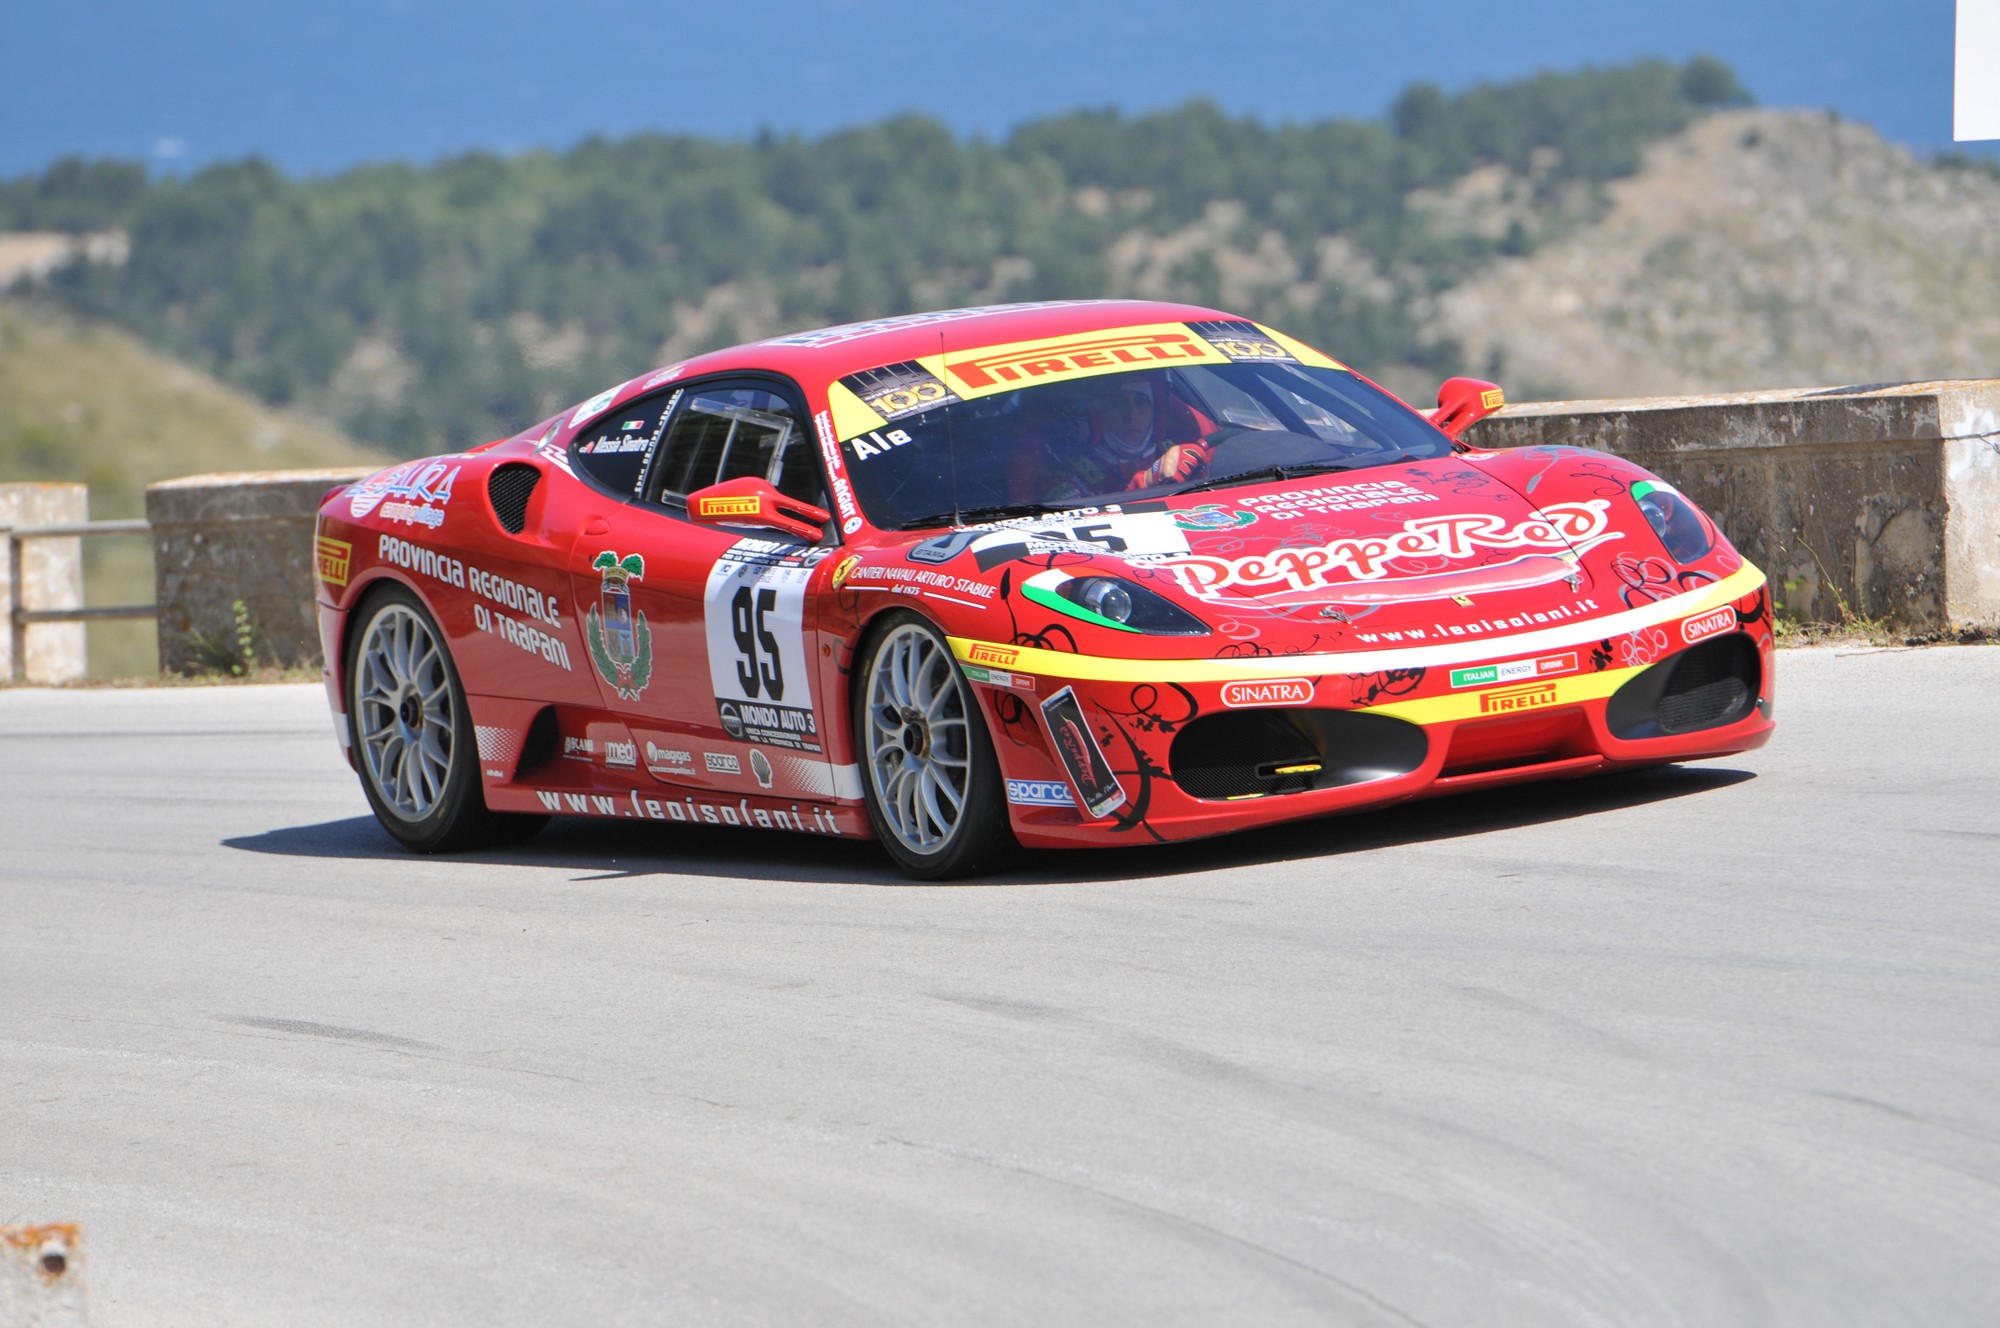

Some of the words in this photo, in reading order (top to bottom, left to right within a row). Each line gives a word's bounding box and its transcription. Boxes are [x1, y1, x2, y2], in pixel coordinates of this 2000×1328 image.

[945, 334, 1207, 389] PIRELLI
[1215, 340, 1289, 359] 100
[871, 383, 946, 413] 100
[851, 430, 912, 460] Ale
[702, 498, 758, 514] PIRELLI
[1104, 504, 1122, 513] 3
[1270, 510, 1305, 521] DI
[850, 566, 884, 579] CANTIERI
[883, 568, 914, 582] NAVALI
[913, 571, 955, 589] ARTURO
[954, 578, 997, 599] STABILE
[473, 603, 493, 635] DI
[1356, 598, 1599, 643] www.leoisolani.it
[1687, 611, 1734, 639] SINATRA
[732, 586, 784, 701] 95
[969, 643, 1020, 665] PIRELLI
[1463, 669, 1495, 681] ITALIAN
[1501, 664, 1533, 676] ENERGY
[1540, 659, 1564, 670] DRINK
[1231, 684, 1305, 702] SINATRA
[1479, 682, 1557, 713] PIRELLI
[740, 704, 779, 728] MONDO
[780, 709, 807, 732] AUTO
[806, 713, 816, 733] 3
[705, 753, 739, 771] sparco
[536, 788, 842, 836] www.leoisolani.it
